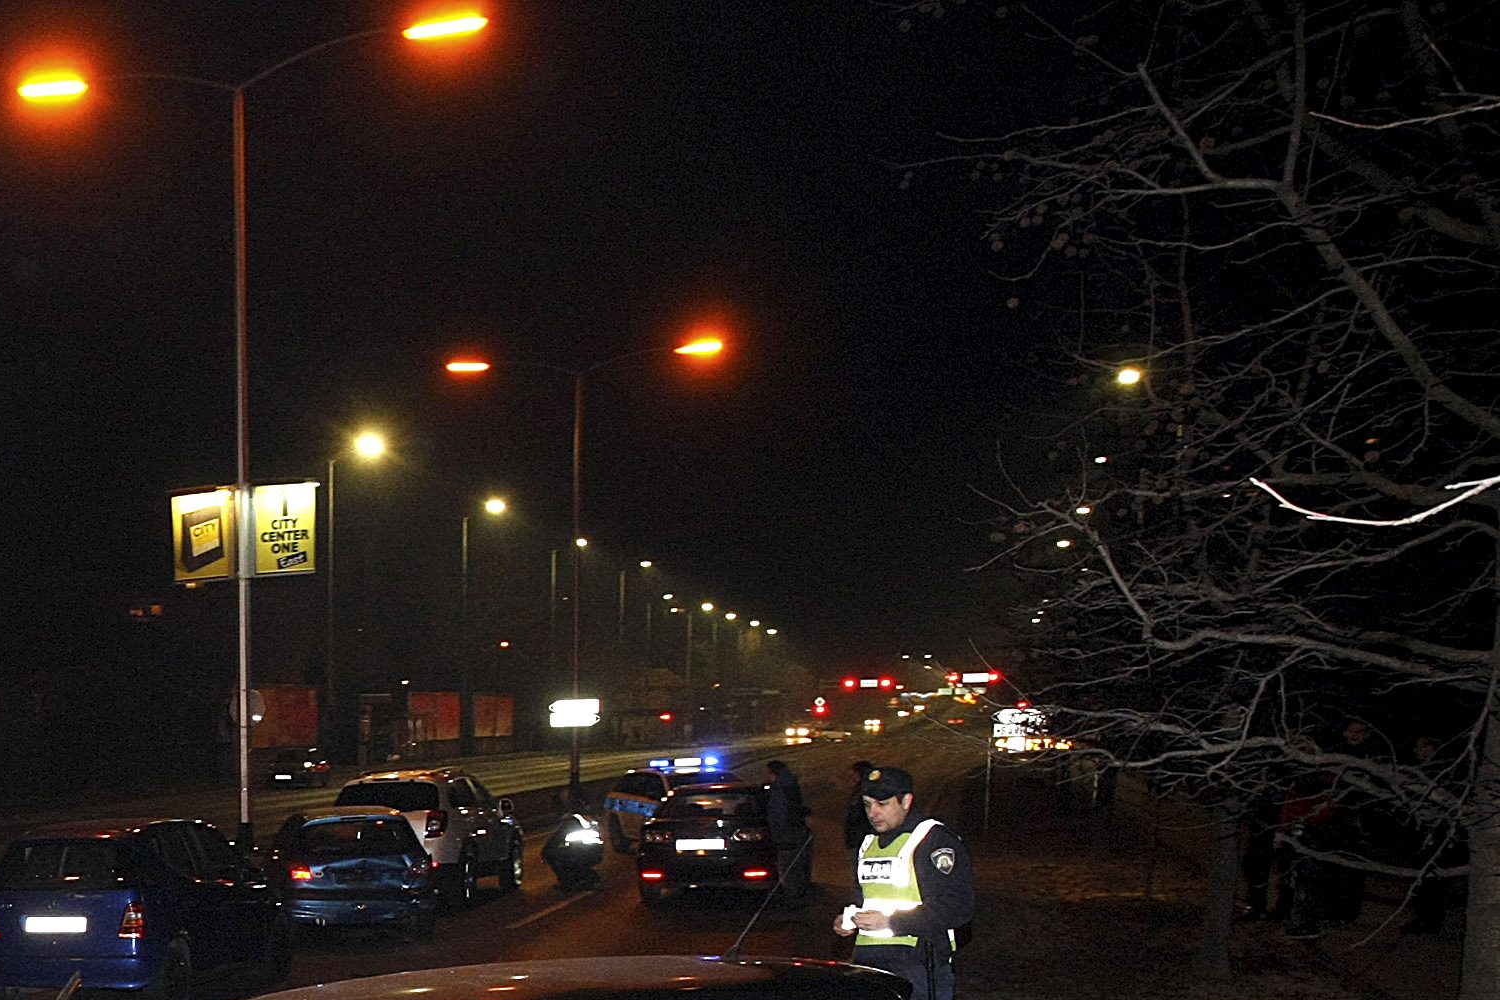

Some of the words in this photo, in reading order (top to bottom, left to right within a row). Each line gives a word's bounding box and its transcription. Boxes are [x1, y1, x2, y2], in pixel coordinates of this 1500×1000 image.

[193, 521, 217, 537] CITY
[271, 518, 299, 530] CITY
[260, 529, 309, 543] CENTER
[270, 541, 299, 554] ONE
